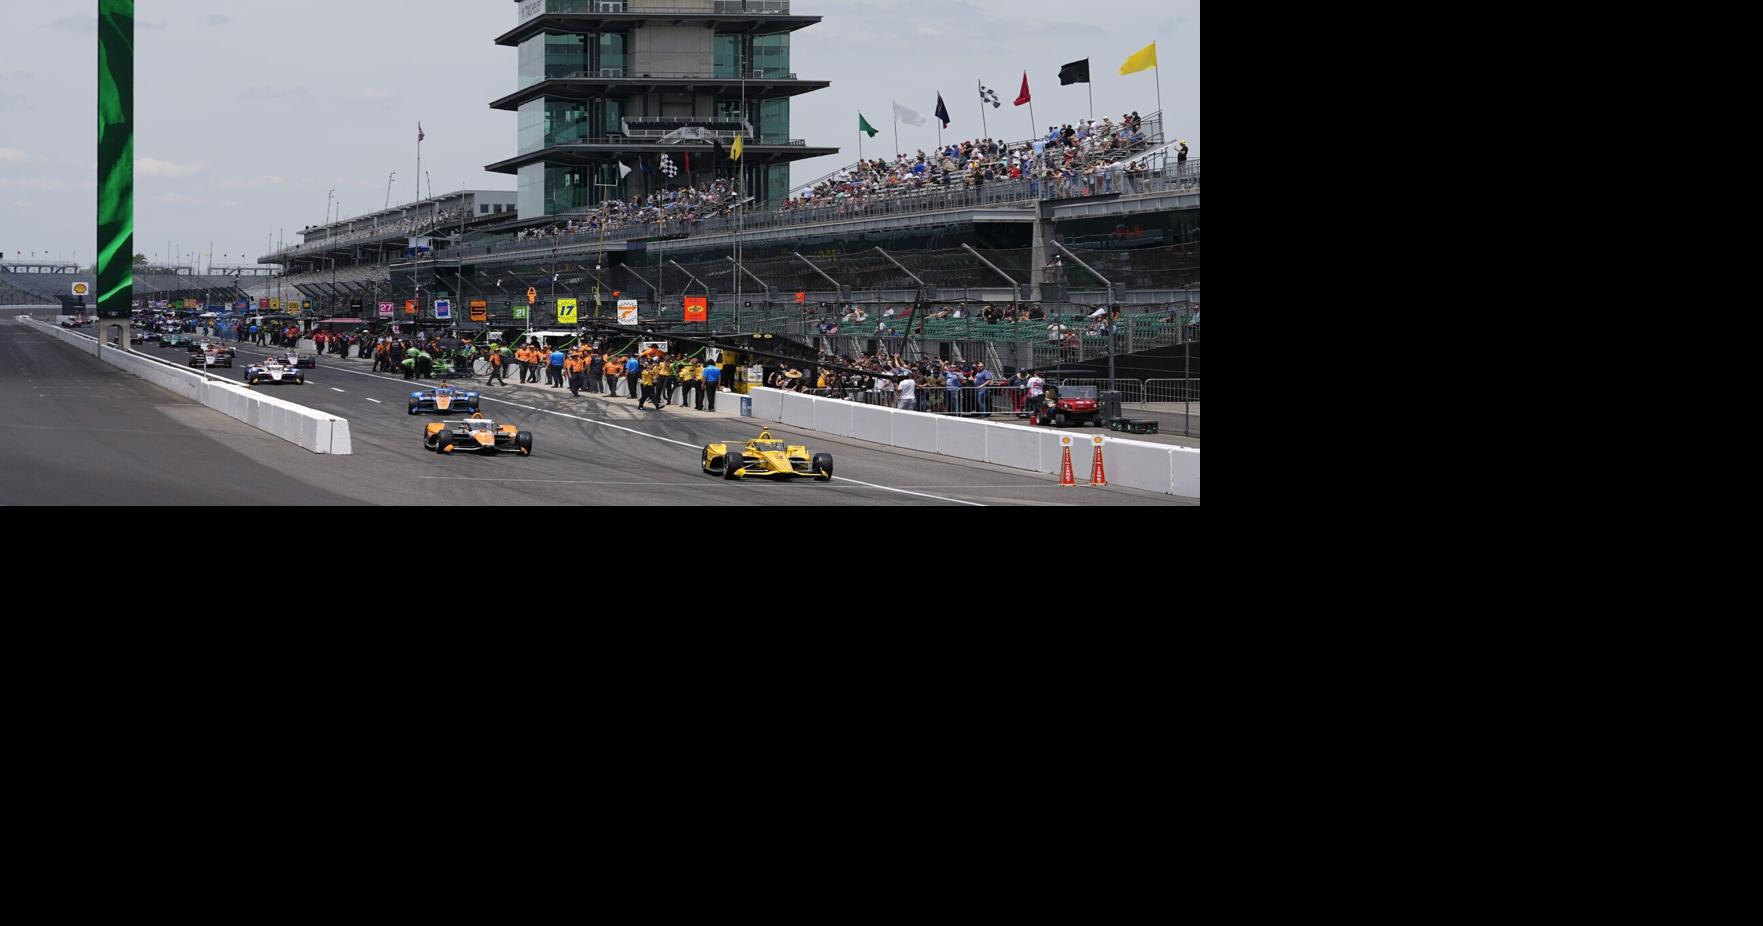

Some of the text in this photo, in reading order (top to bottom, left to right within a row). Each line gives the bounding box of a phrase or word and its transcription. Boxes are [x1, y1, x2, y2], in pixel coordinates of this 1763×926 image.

[380, 303, 392, 312] 27
[516, 308, 526, 317] 21
[560, 305, 575, 316] 17
[618, 306, 637, 318] 7
